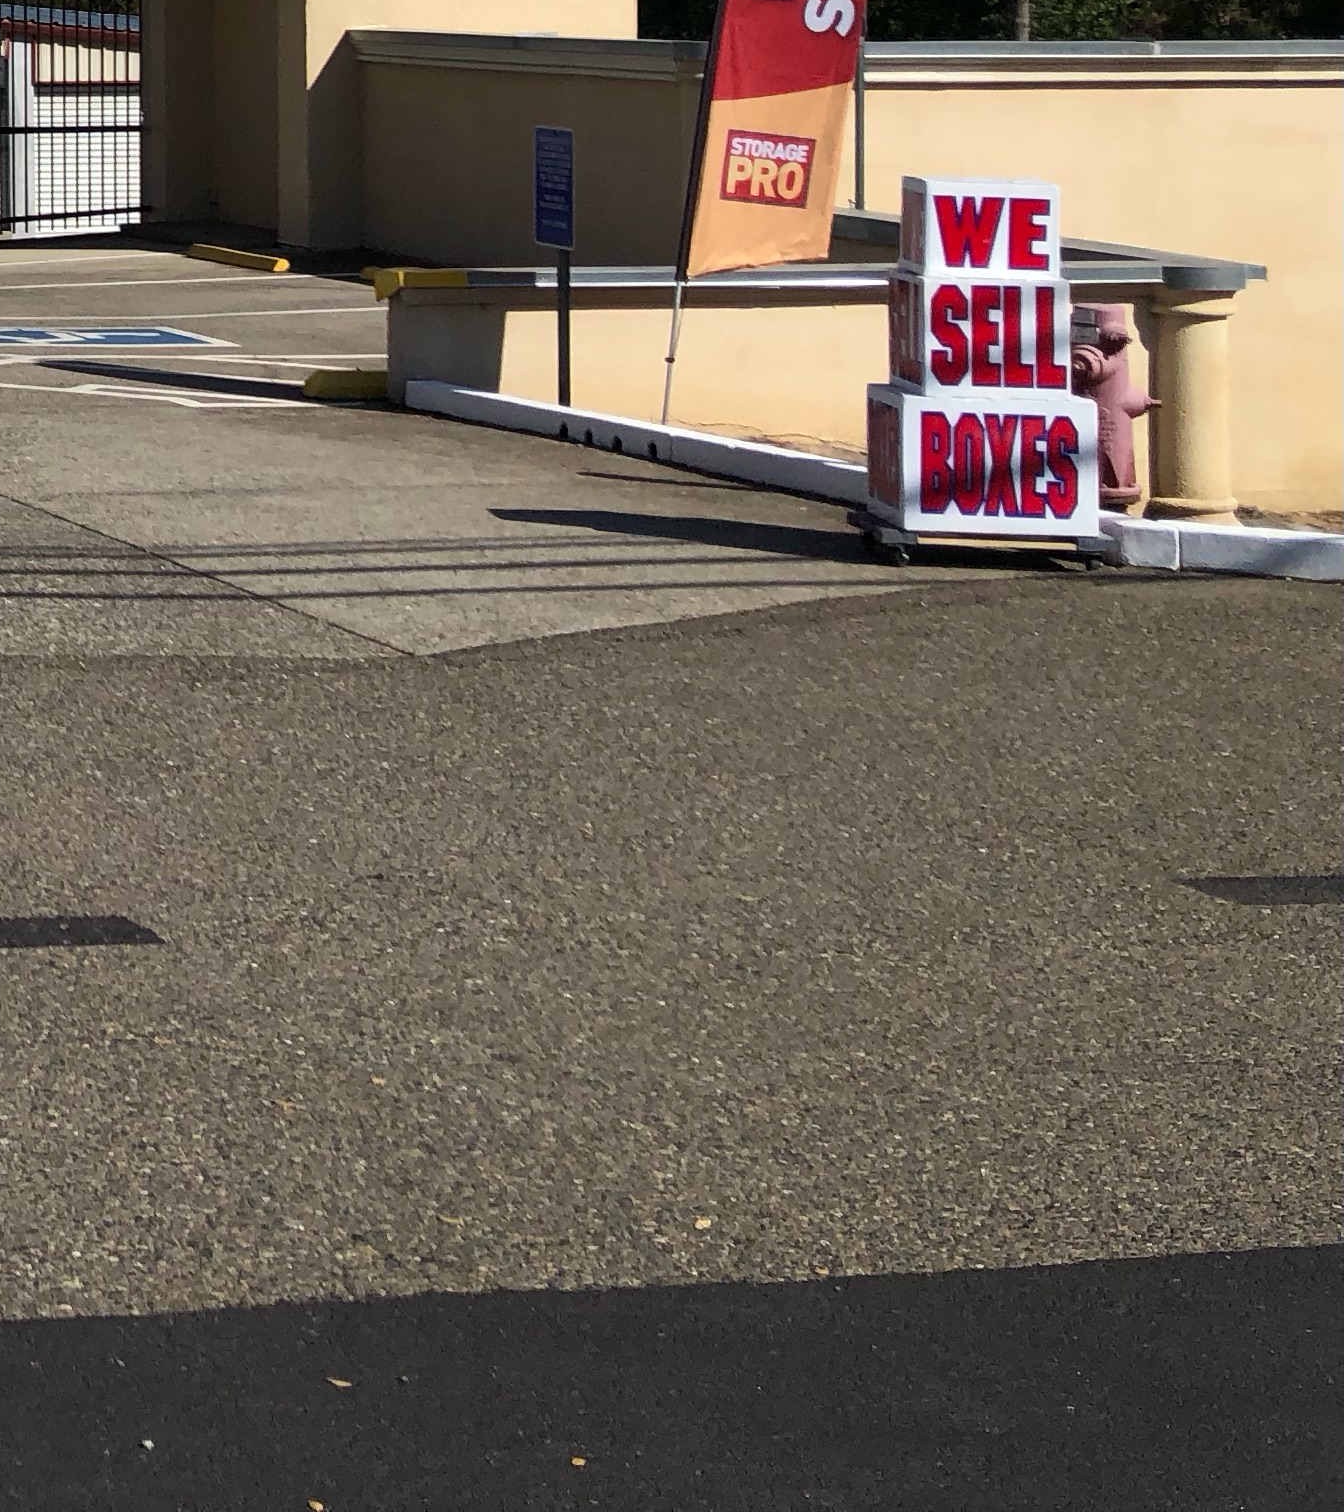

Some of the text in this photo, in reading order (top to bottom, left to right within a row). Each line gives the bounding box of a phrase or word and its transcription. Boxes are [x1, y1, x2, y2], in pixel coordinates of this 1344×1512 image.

[726, 155, 805, 200] PRO
[730, 137, 810, 163] STORAGE
[932, 194, 1052, 272] WE
[929, 283, 1068, 389] SELL
[919, 410, 1080, 520] BOXES
